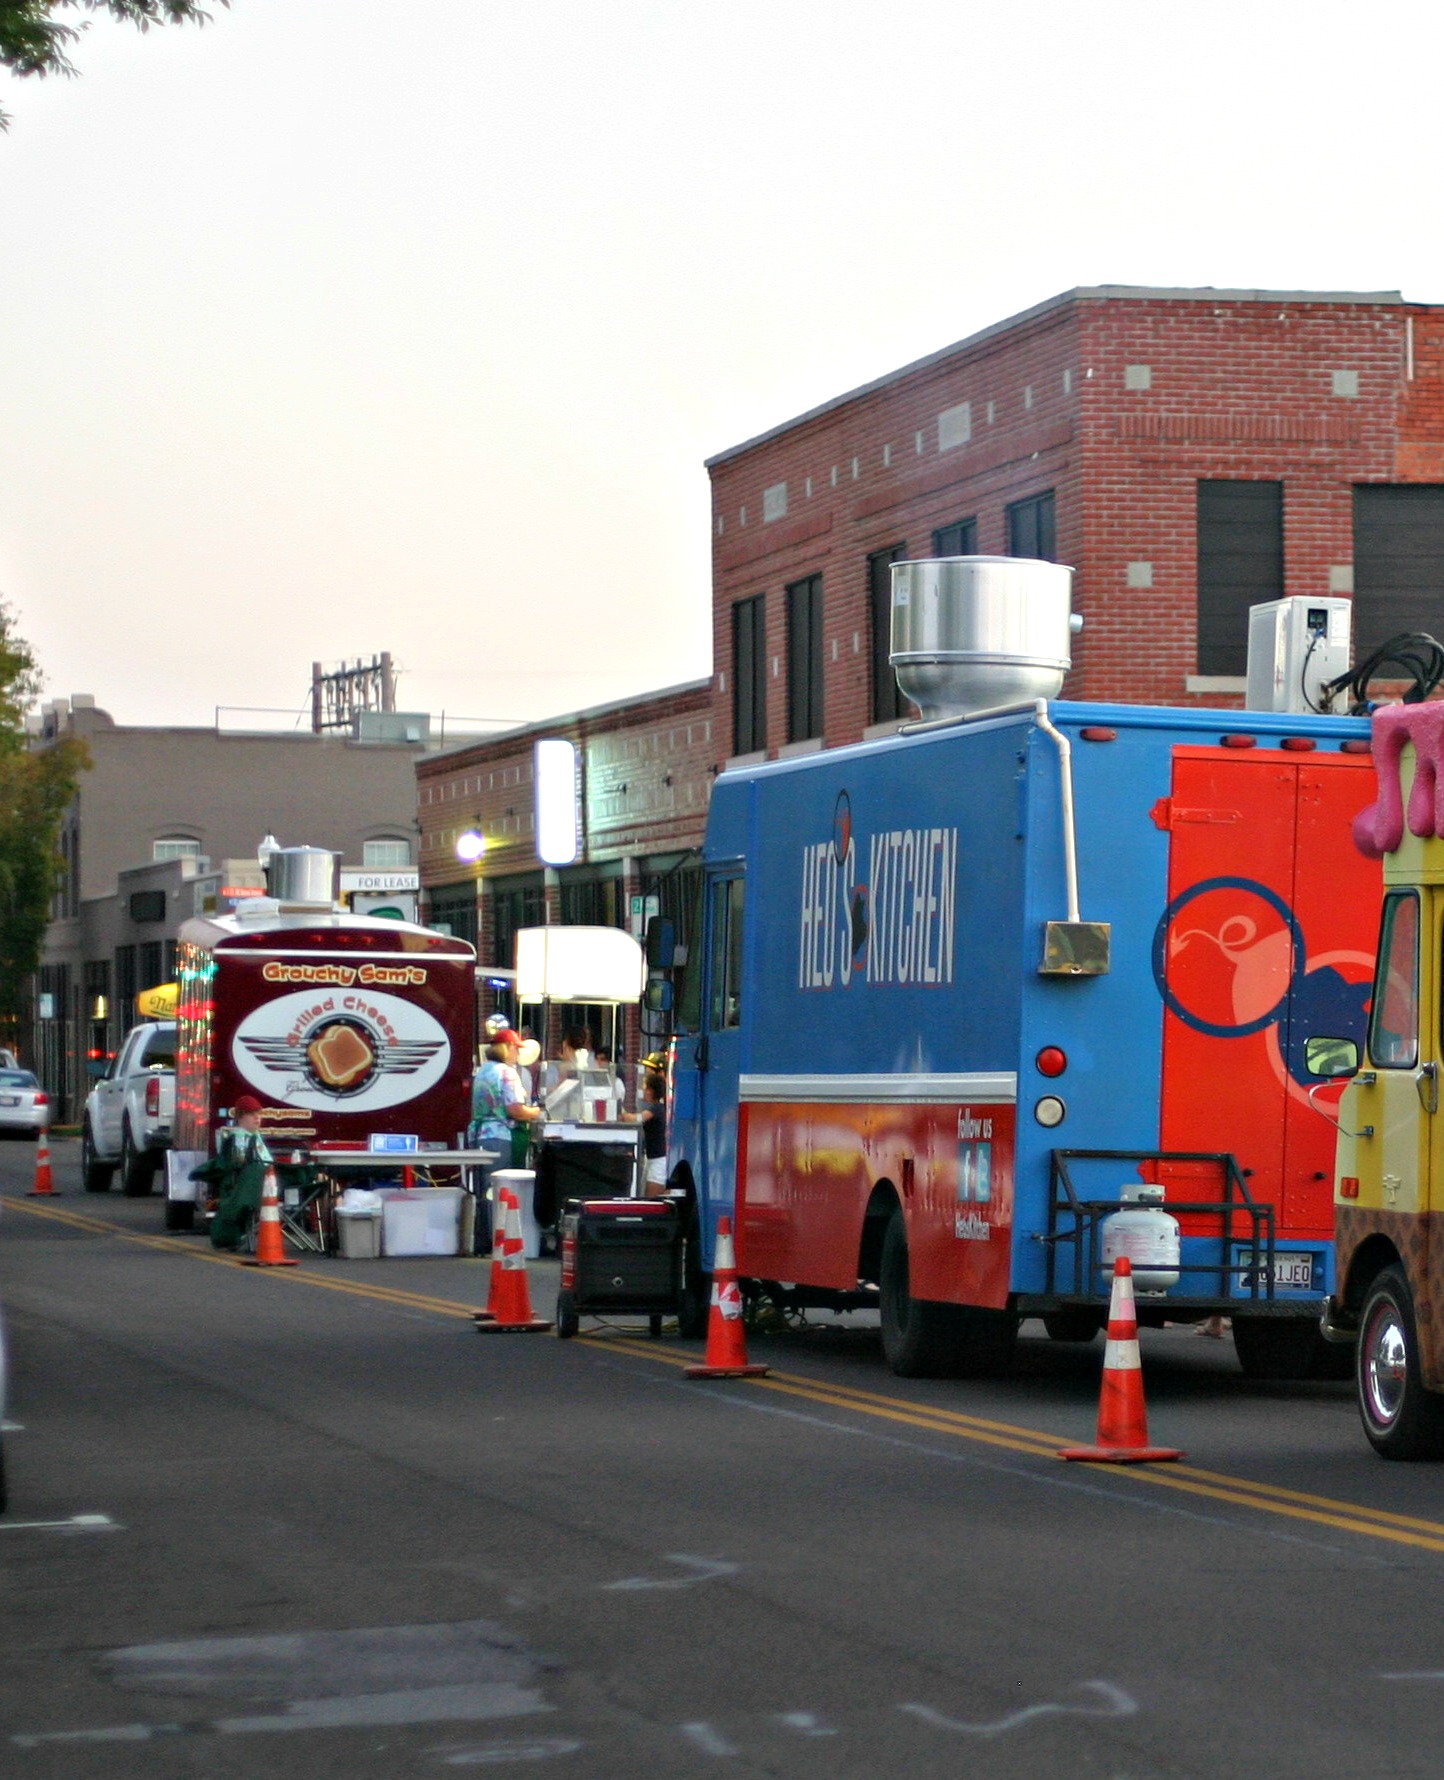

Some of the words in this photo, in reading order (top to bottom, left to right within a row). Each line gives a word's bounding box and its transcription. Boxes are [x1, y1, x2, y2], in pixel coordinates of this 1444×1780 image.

[358, 876, 380, 888] FOR
[383, 876, 418, 888] LEASE
[866, 827, 958, 984] KITCHEN
[263, 962, 356, 986] Grouchy
[358, 963, 427, 985] Sam's
[287, 998, 335, 1047] Grilled
[343, 997, 399, 1047] Cheese
